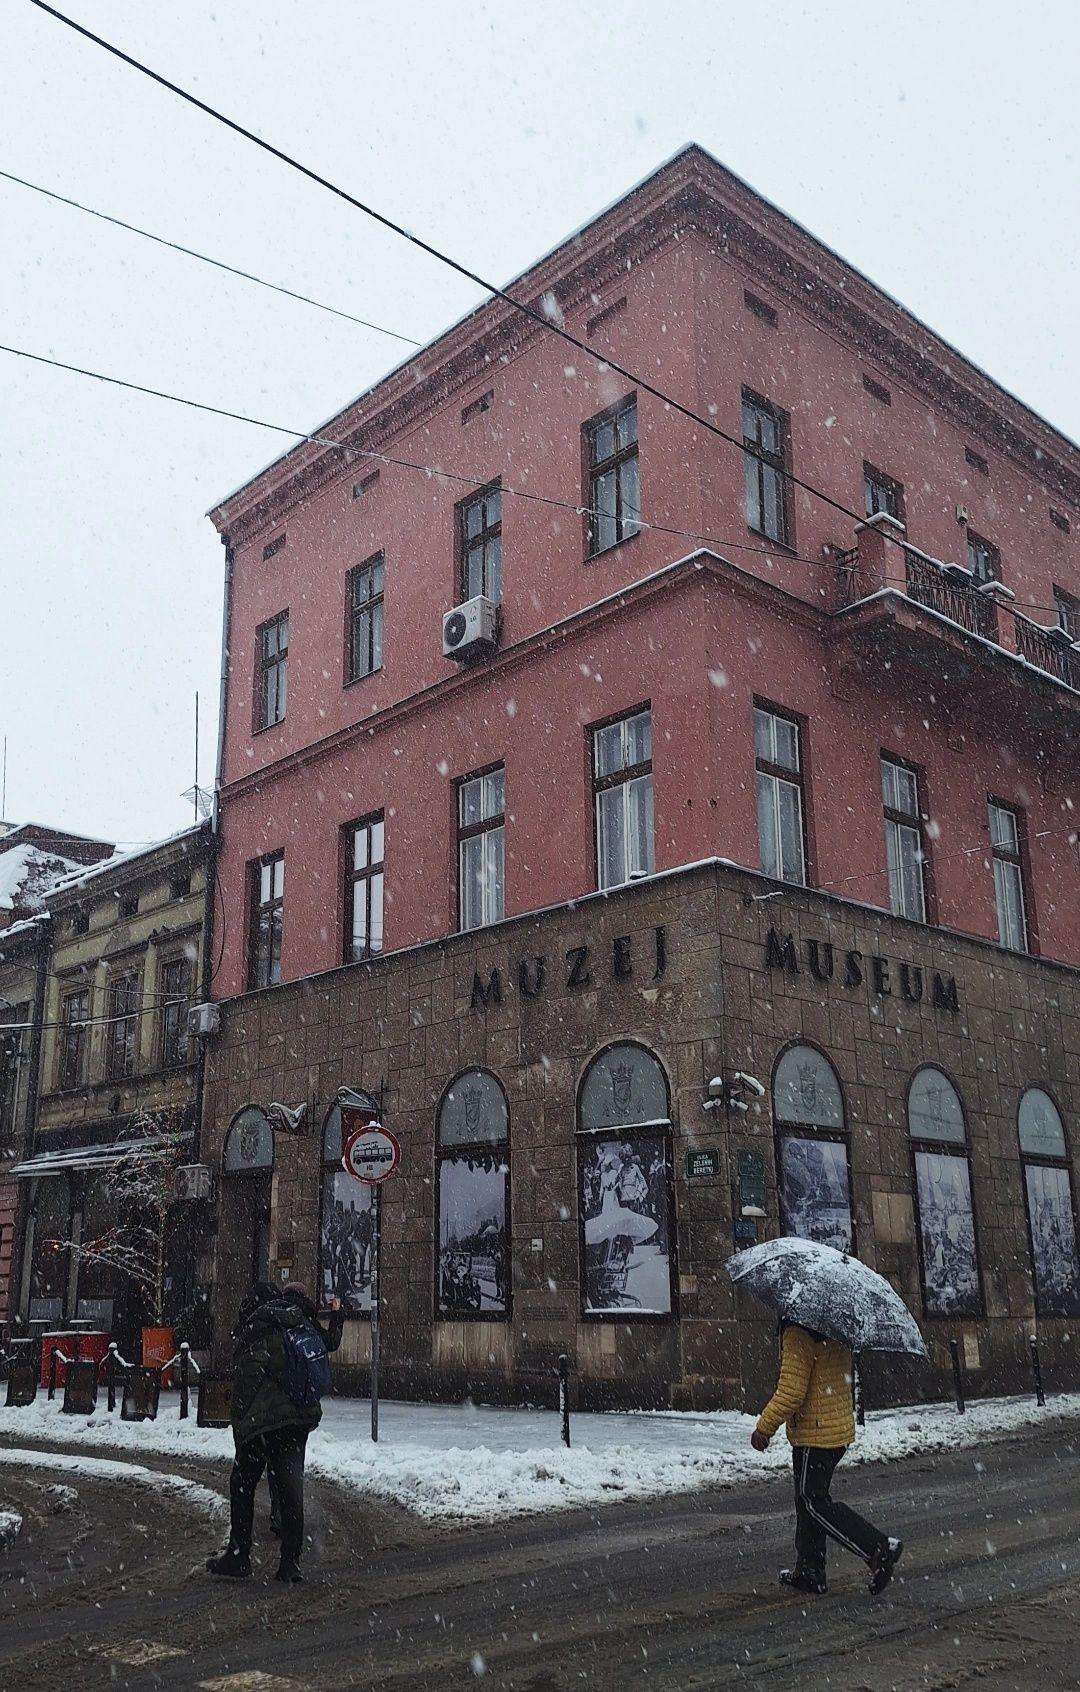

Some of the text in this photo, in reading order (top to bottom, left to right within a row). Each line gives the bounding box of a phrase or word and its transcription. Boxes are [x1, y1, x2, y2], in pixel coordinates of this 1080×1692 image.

[469, 926, 667, 1009] MUZEJ
[765, 927, 961, 1012] MUSEUM
[693, 1159, 712, 1167] ZELENIH
